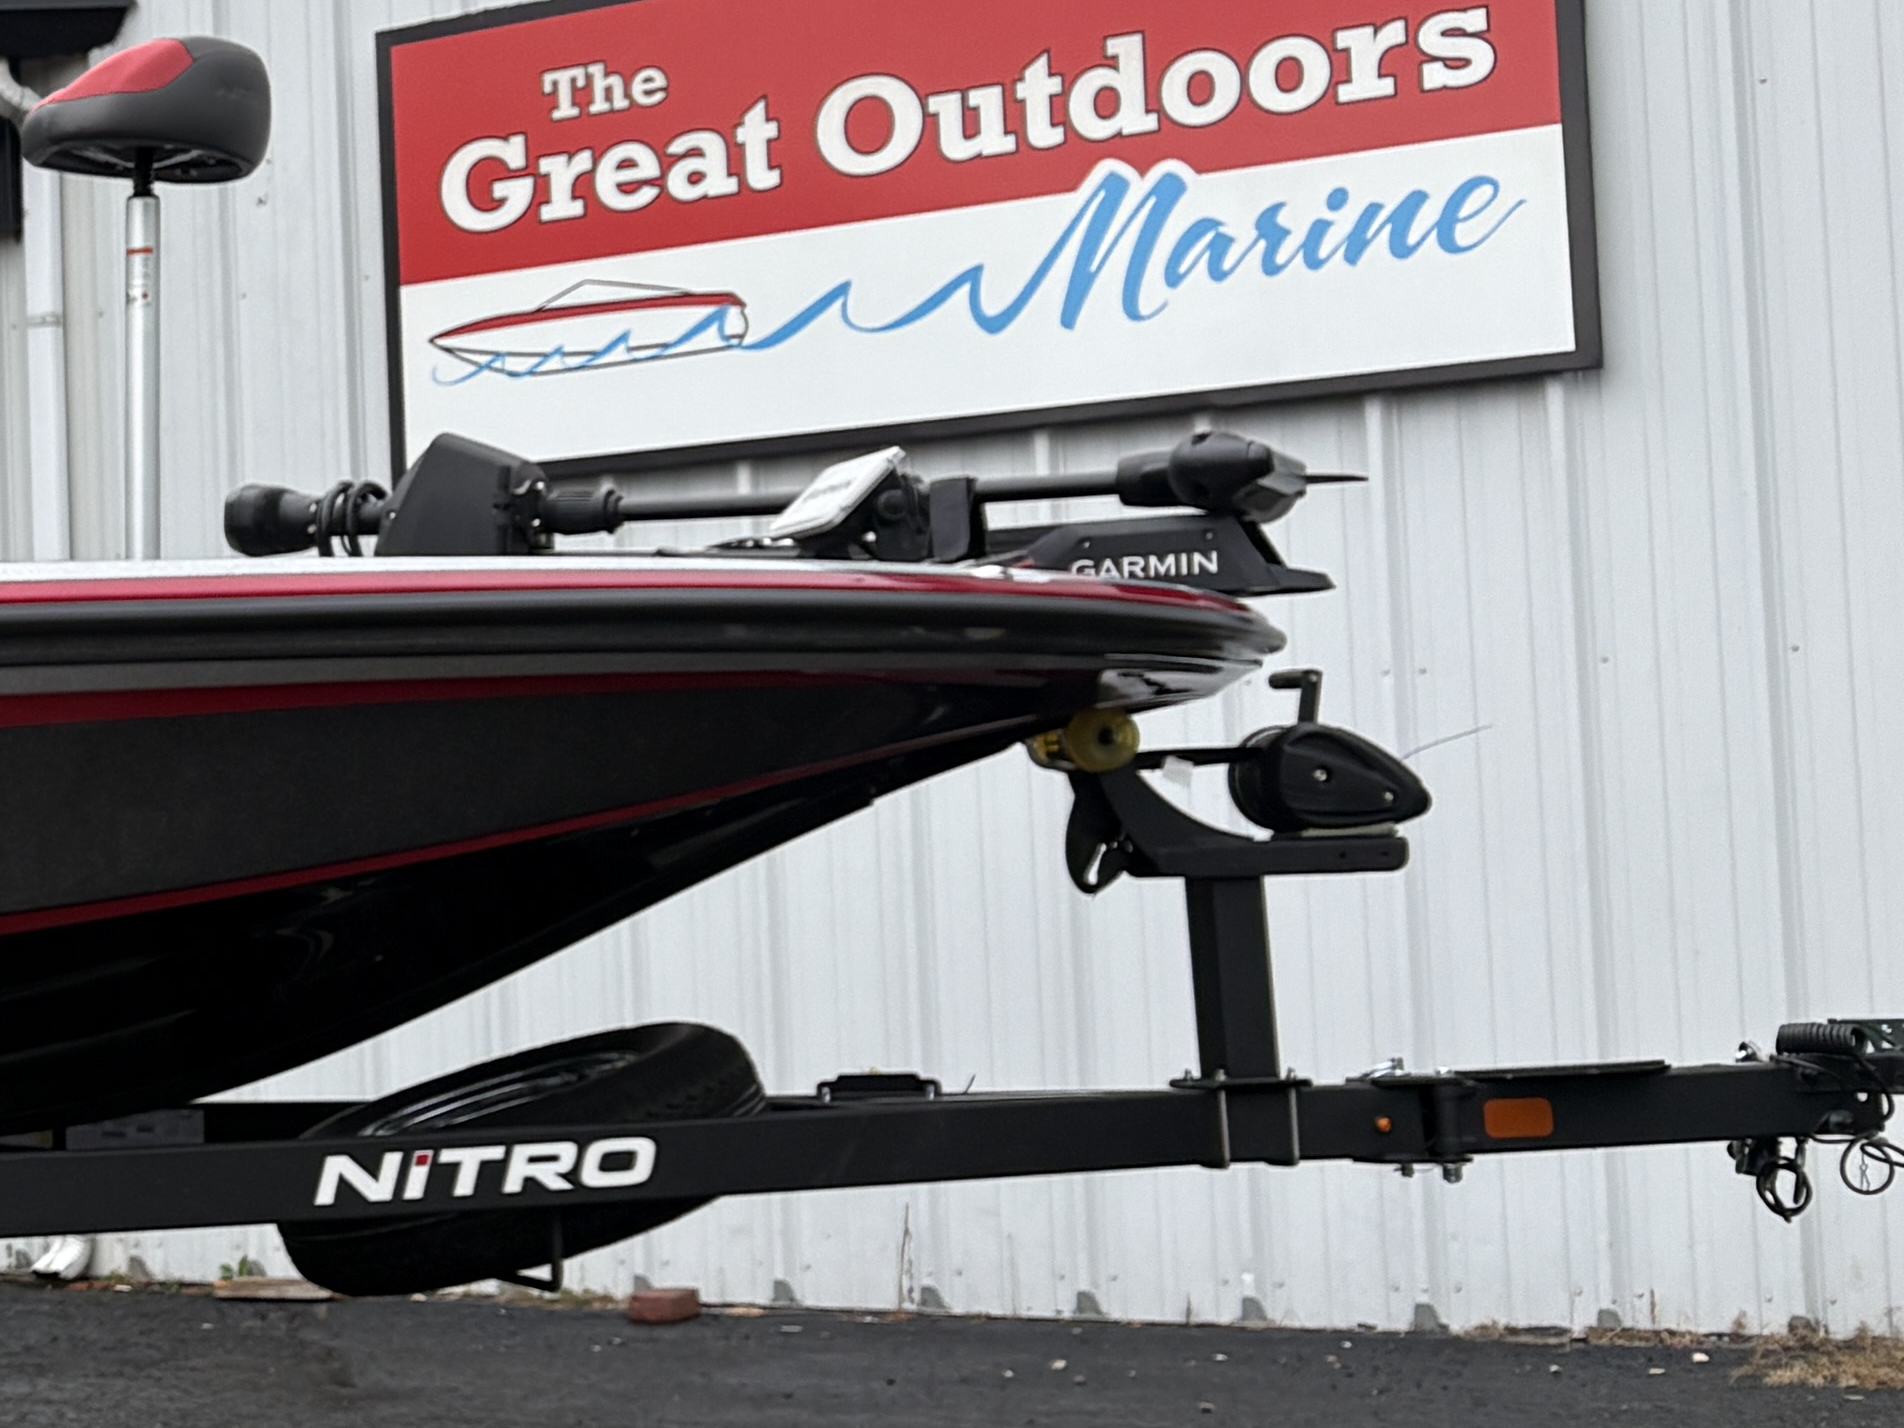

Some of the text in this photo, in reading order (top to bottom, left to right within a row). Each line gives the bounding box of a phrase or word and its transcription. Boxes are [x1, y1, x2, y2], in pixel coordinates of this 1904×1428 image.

[440, 3, 1498, 234] Great Outdoors
[542, 60, 669, 122] The
[987, 171, 1528, 332] Marine
[1070, 550, 1219, 580] GARMIN
